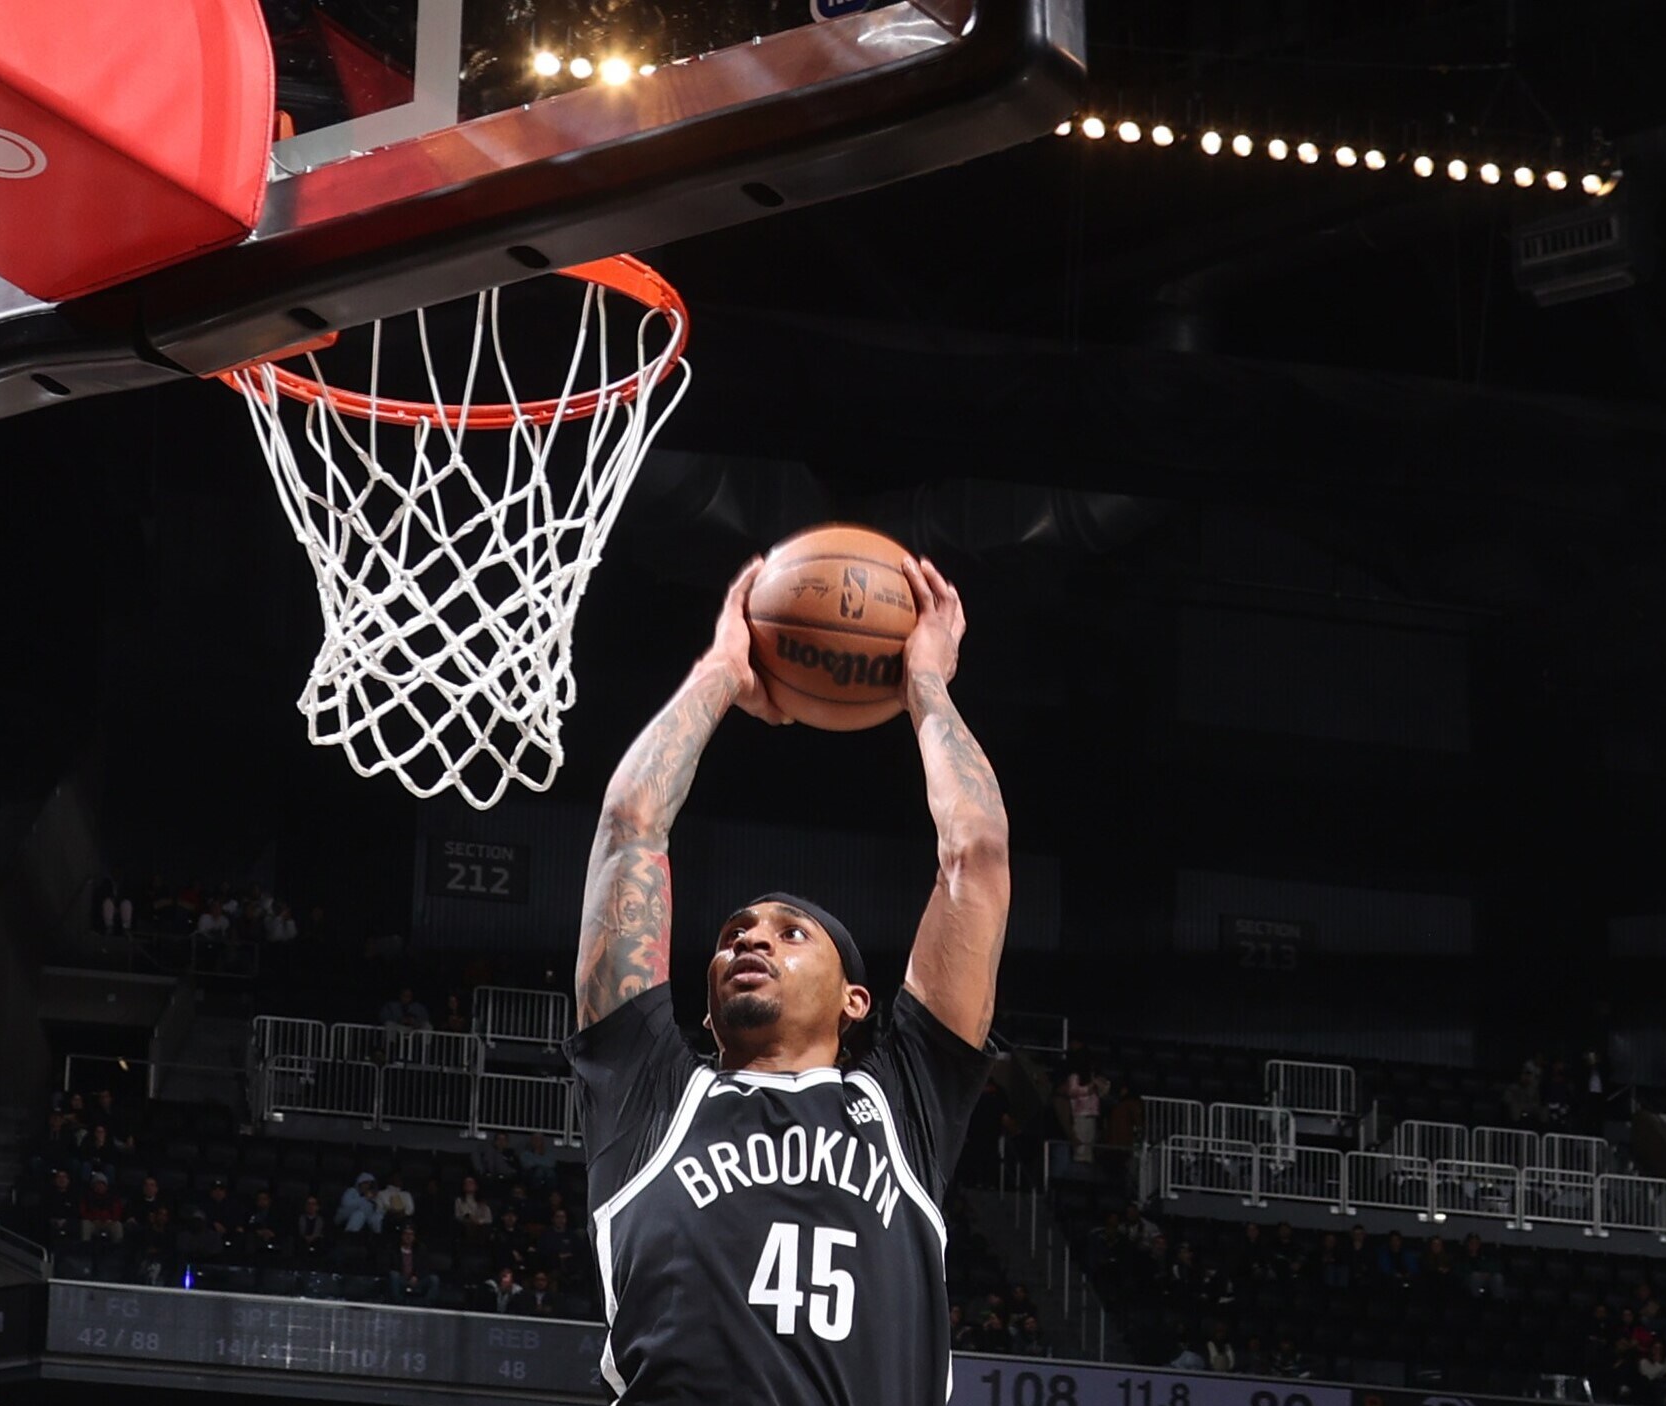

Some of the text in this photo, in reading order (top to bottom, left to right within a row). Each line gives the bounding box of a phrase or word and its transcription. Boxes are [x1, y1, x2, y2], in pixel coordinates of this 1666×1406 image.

[444, 841, 514, 860] SECTION
[446, 862, 510, 895] 212
[1235, 918, 1301, 938] SECTION
[1238, 939, 1296, 971] 213
[673, 1124, 900, 1230] BROOKLYN
[748, 1221, 857, 1342] 45
[106, 1297, 140, 1319] FG
[77, 1327, 107, 1346] 42
[130, 1330, 160, 1351] 88
[487, 1328, 540, 1350] REB
[402, 1351, 427, 1373] 13
[498, 1360, 526, 1380] 48
